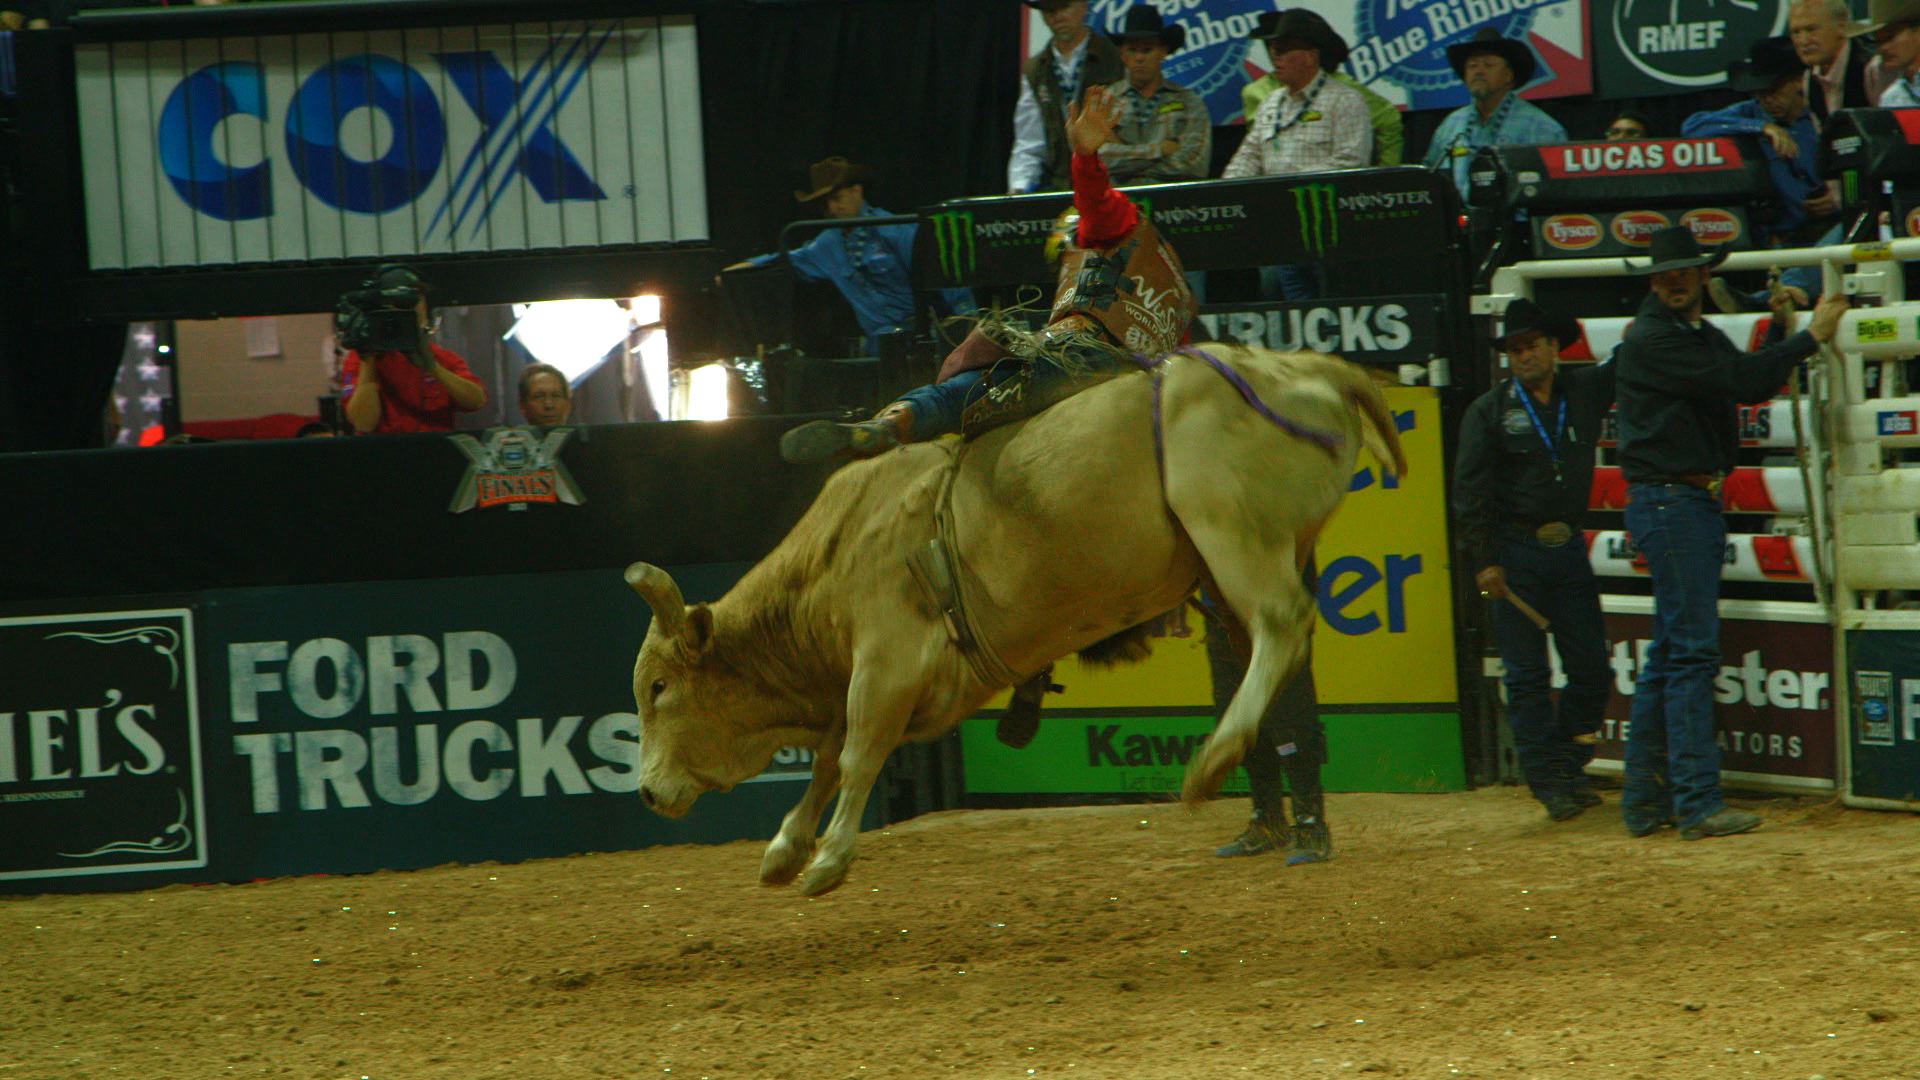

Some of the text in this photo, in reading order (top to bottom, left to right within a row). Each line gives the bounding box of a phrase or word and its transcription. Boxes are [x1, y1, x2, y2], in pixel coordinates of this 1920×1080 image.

[1637, 20, 1727, 54] RMEF
[1349, 26, 1430, 84] Blue
[158, 25, 612, 240] COX
[1563, 140, 1725, 173] LUCAS OIL
[1154, 203, 1248, 226] MONSTER
[1338, 190, 1433, 212] MONSTER
[975, 214, 1059, 238] MONSTE
[1551, 221, 1598, 242] Tyson
[1689, 216, 1734, 237] Tyson
[1197, 303, 1412, 353] TRUCKS
[480, 474, 556, 500] FINALS
[228, 631, 518, 723] FORD
[232, 711, 641, 815] TRUCKS
